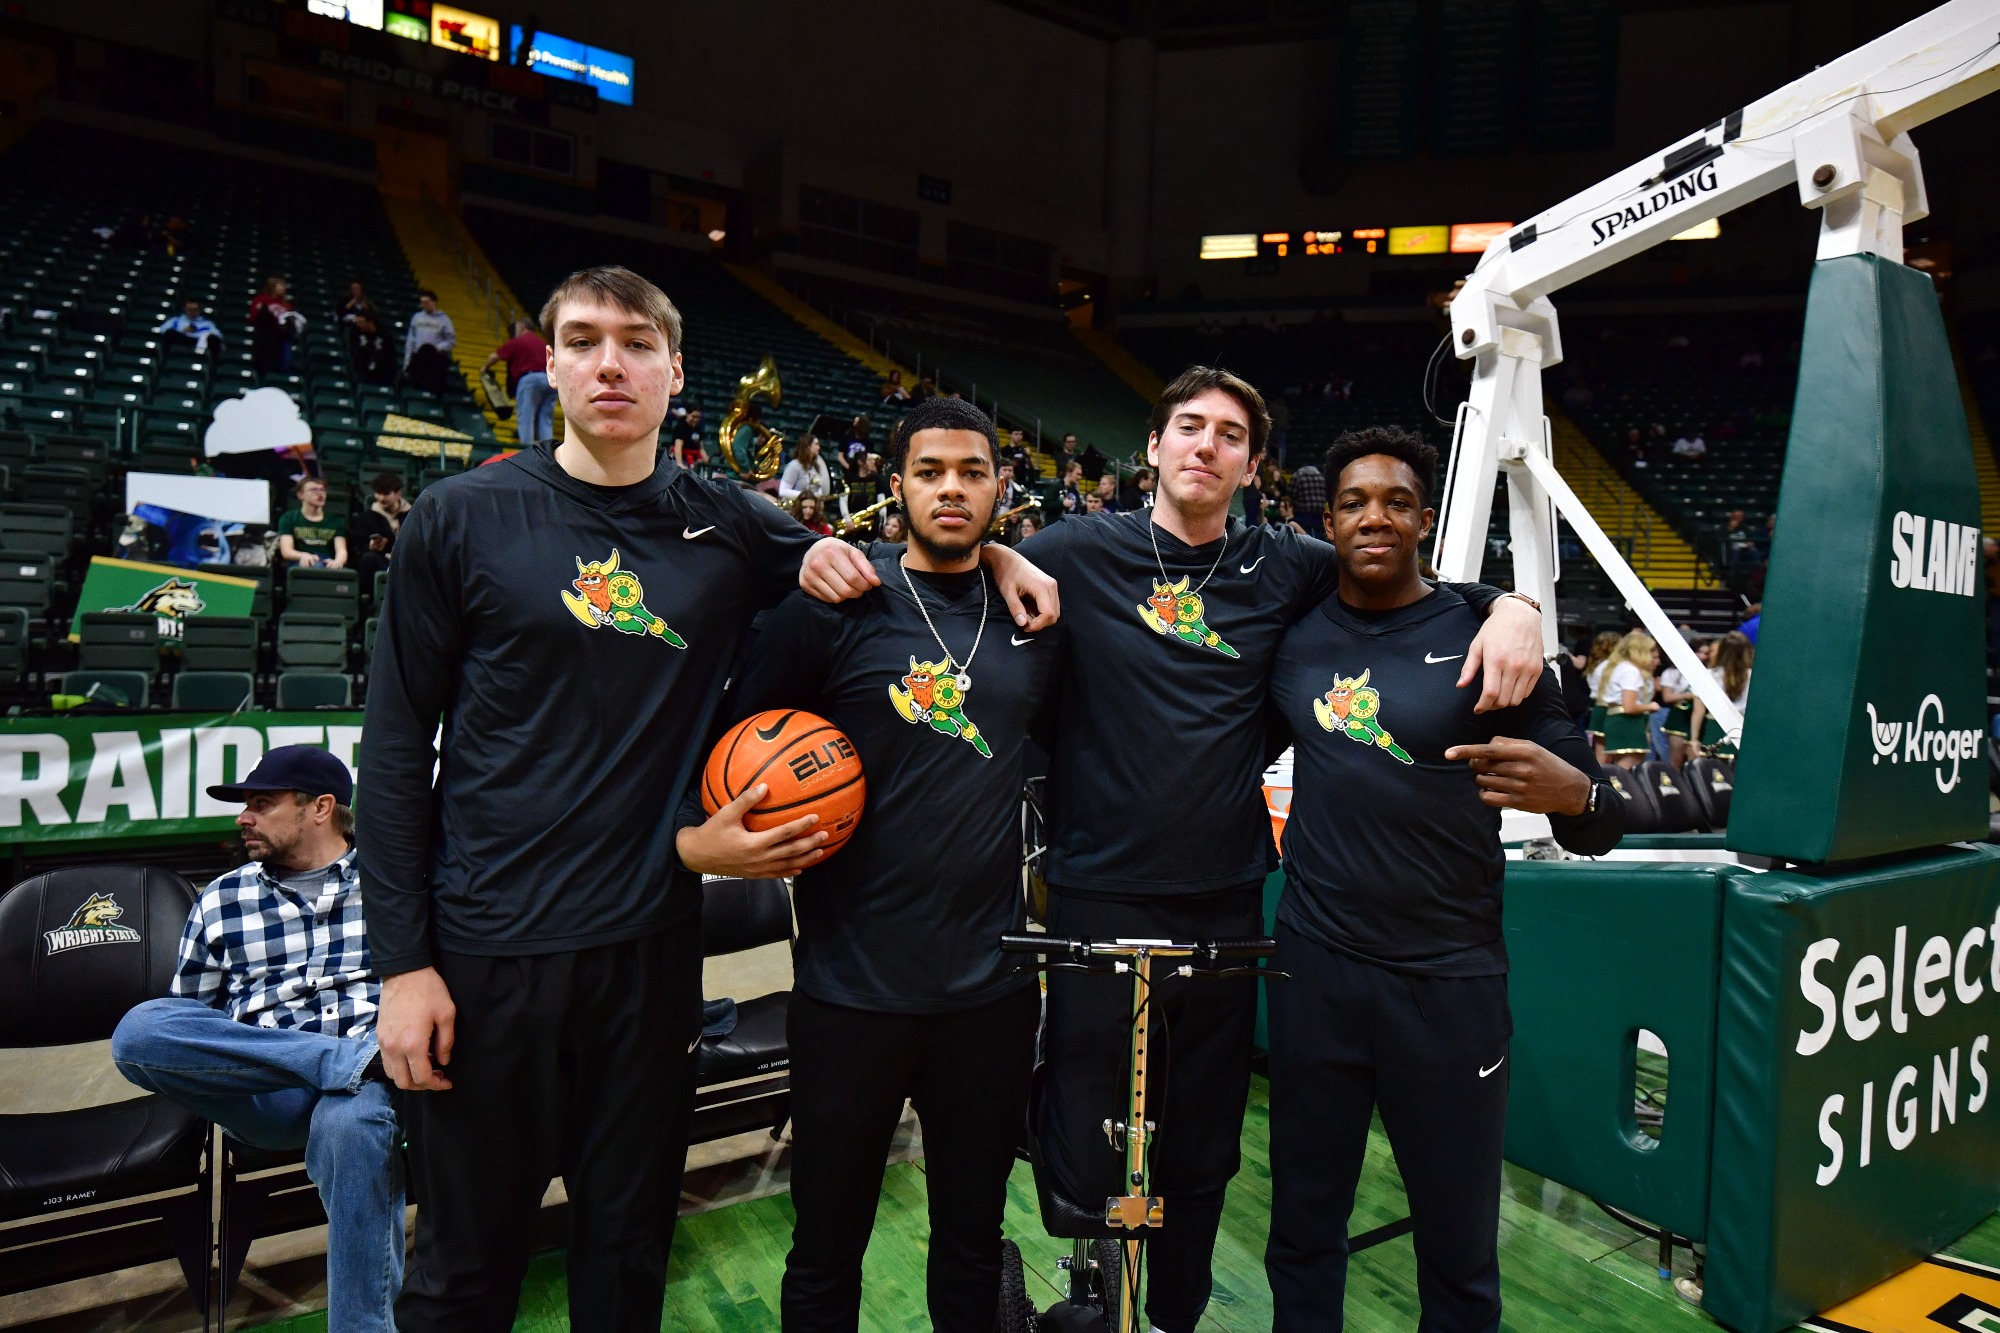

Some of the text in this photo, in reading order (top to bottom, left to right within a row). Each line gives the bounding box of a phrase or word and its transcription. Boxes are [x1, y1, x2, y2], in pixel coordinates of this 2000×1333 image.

[318, 50, 435, 91] RAIDER
[442, 80, 518, 112] PACK
[589, 64, 630, 86] Health
[1591, 161, 1718, 246] SPALDING
[1890, 510, 1978, 597] SLAM
[611, 580, 634, 594] WRIGHT
[616, 592, 636, 604] STATE
[936, 681, 956, 694] WRIGH
[938, 695, 958, 705] STATE
[787, 737, 855, 781] ELITE
[1905, 694, 1983, 794] Kroger
[0, 726, 363, 827] RAID
[49, 928, 138, 951] WRIGHT STATE
[1795, 905, 2000, 1056] Select
[1815, 1034, 1989, 1187] SIGNS
[66, 1190, 97, 1201] RAMEY
